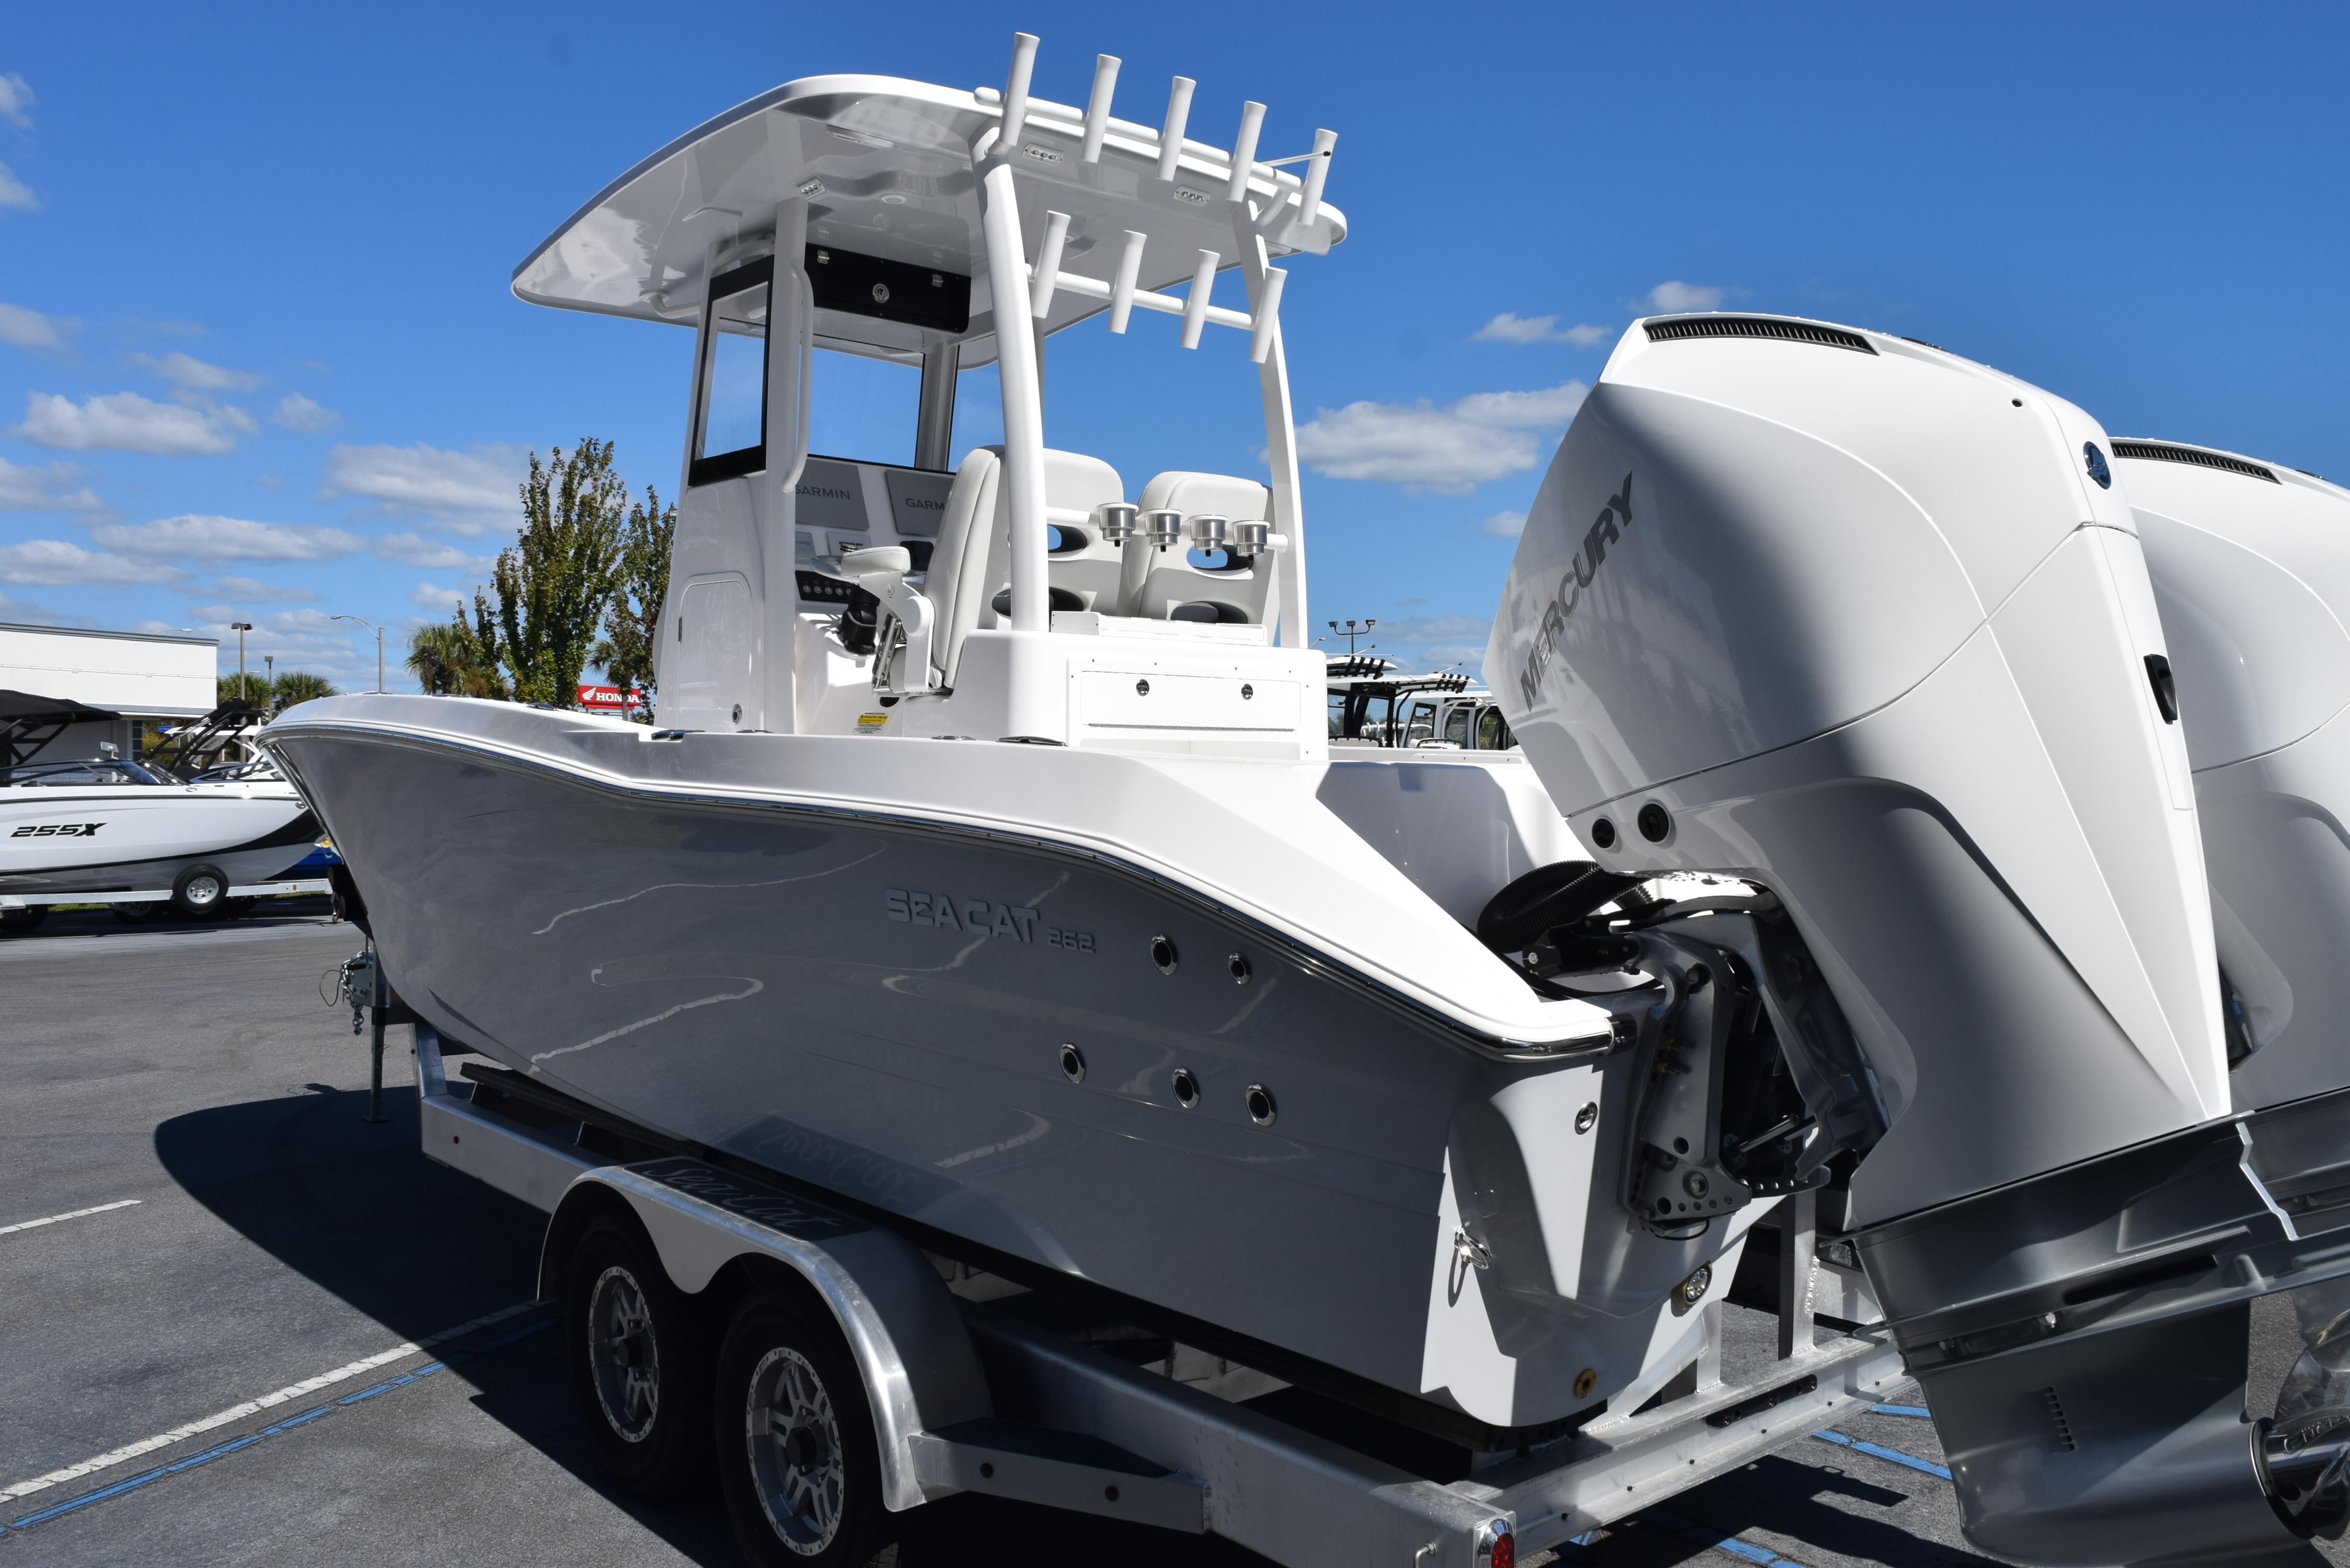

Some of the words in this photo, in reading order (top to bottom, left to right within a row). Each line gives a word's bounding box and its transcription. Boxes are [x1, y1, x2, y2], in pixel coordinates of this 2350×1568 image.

[905, 498, 946, 511] GARM
[1520, 470, 1633, 713] MERCURY
[10, 822, 109, 838] 255X
[1047, 927, 1096, 954] 262
[642, 1168, 742, 1195] Sea
[721, 1194, 844, 1228] Cat
